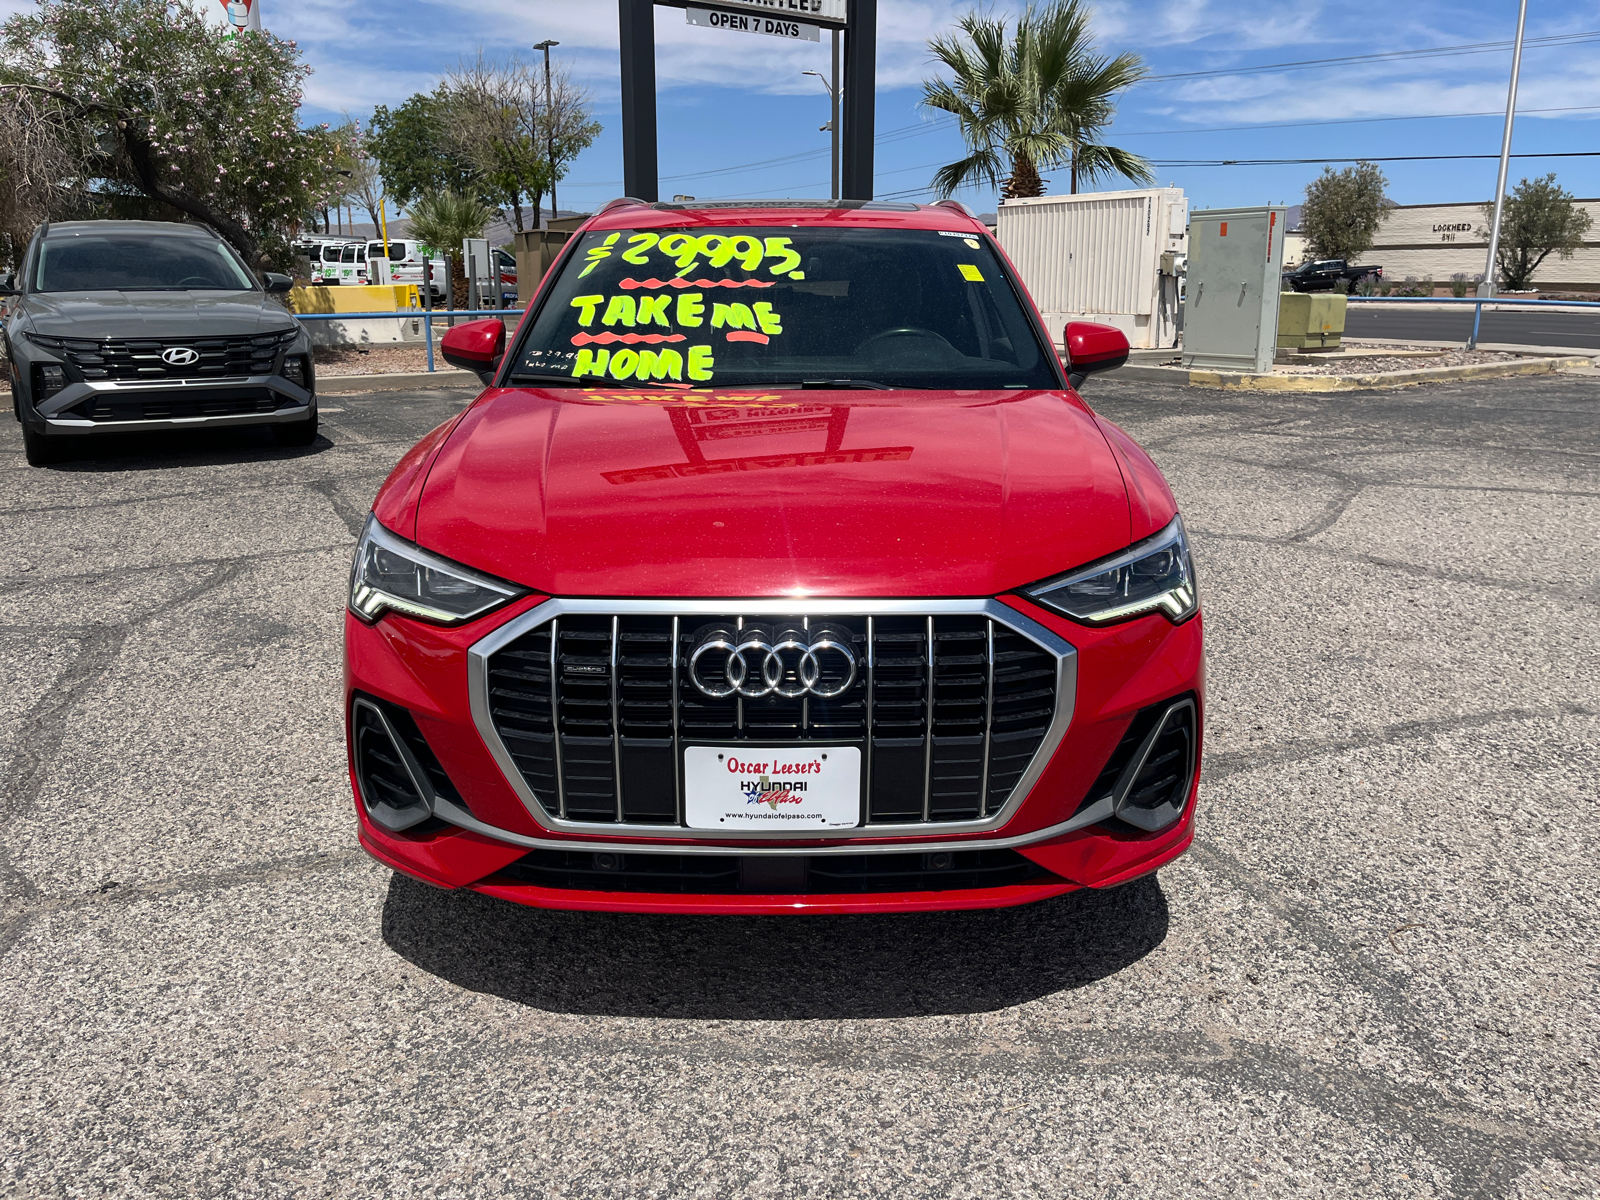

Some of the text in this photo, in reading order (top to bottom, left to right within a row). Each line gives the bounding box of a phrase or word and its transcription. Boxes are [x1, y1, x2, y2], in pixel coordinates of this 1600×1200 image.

[709, 12, 800, 37] OPEN 7 DAYS
[1432, 223, 1472, 232] LOCKHEED
[570, 293, 783, 334] TAKE ME
[572, 345, 714, 381] HOME
[727, 757, 821, 775] Oscar Leeser's
[740, 781, 808, 792] HYUNDAI
[725, 812, 823, 820] www.hyundaiofelpaso.com
